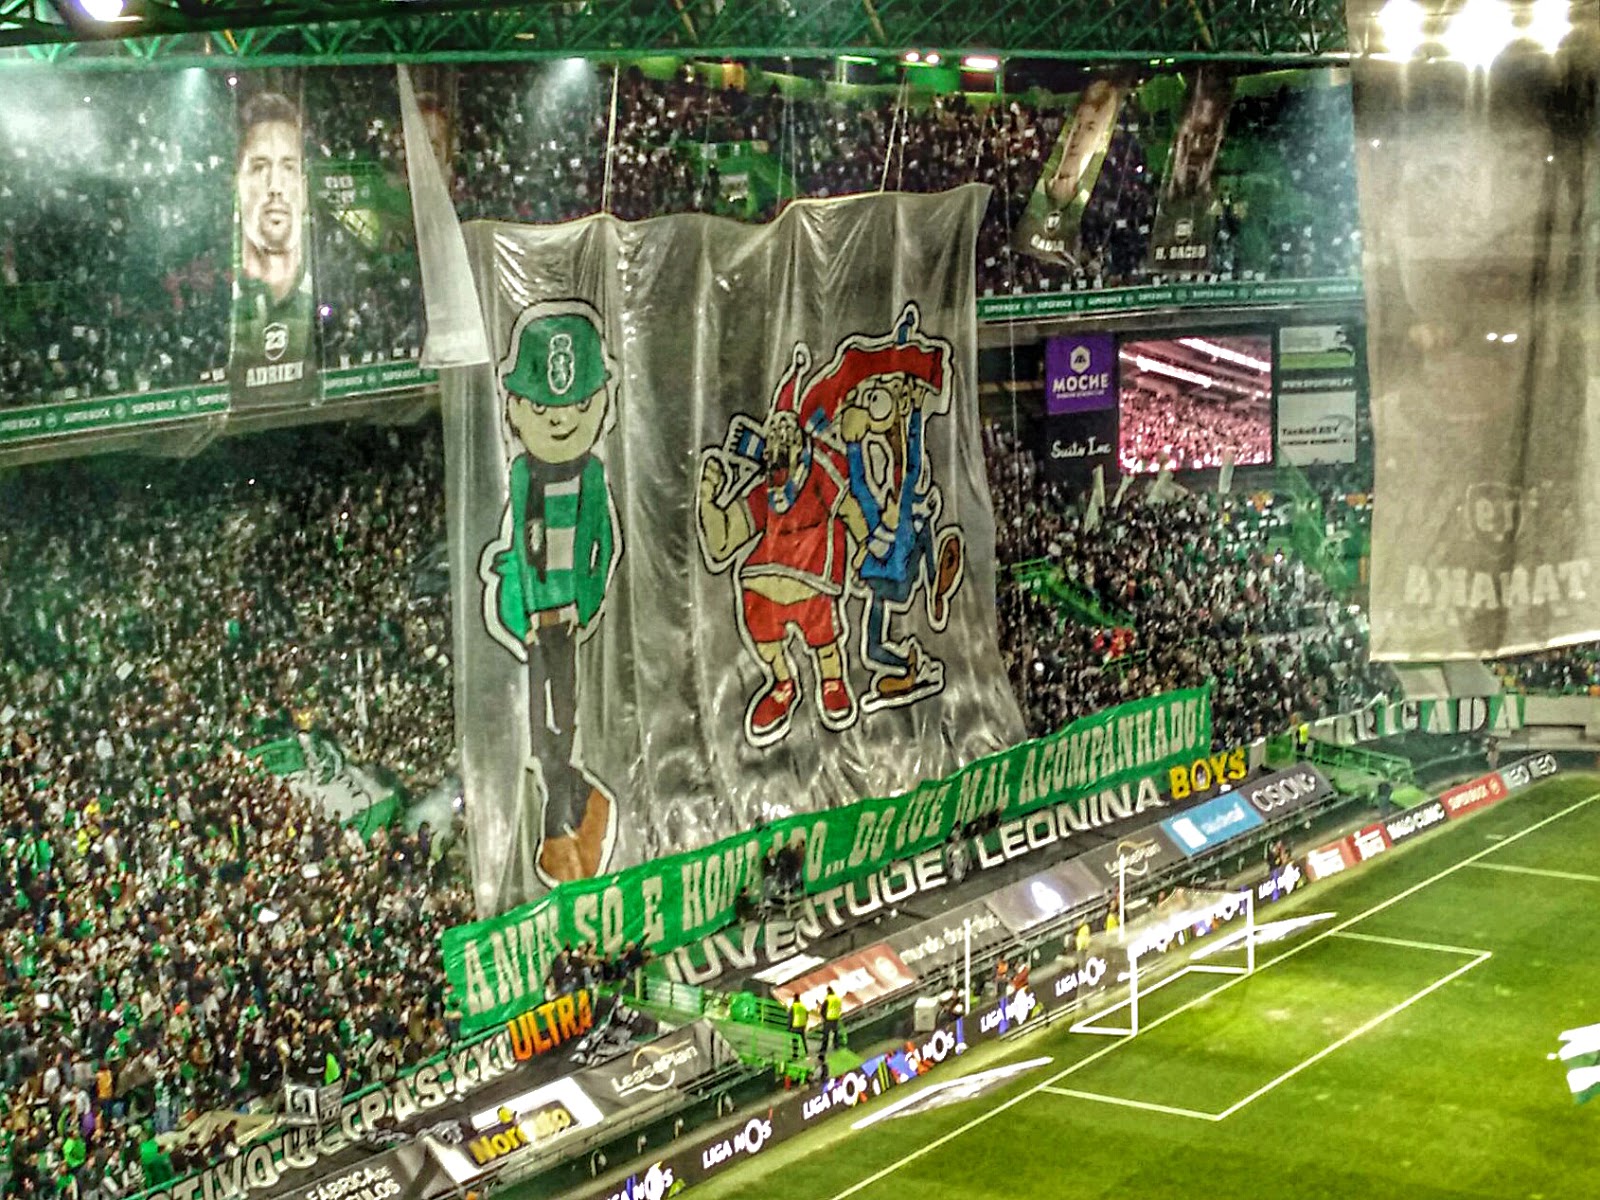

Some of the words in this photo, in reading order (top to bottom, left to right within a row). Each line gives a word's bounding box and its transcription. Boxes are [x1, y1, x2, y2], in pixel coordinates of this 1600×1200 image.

[1053, 374, 1109, 393] MOCHE
[954, 759, 1011, 825] MAL
[1019, 693, 1207, 805] ACOMPANHADO!
[1169, 747, 1247, 799] BOYS
[975, 778, 1169, 869] LEONINA
[507, 989, 592, 1061] ULTRA
[803, 1093, 832, 1121] LIGA
[703, 1140, 732, 1169] LIGA
[734, 1118, 772, 1154] NOS
